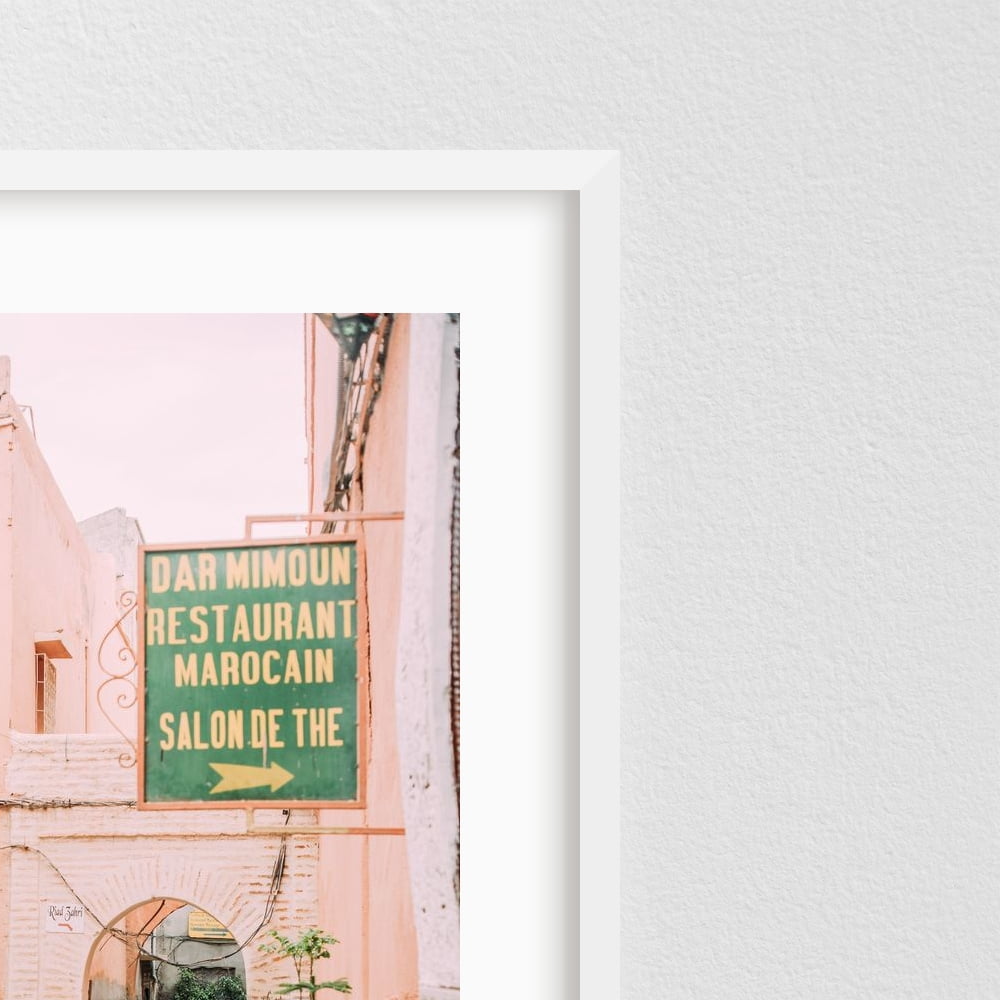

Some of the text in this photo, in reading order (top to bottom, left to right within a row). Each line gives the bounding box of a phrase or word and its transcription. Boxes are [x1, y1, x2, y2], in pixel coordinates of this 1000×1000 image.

[151, 546, 351, 594] DAR MIMOUN
[147, 600, 355, 645] RESTAURANT
[174, 648, 334, 687] MAROCAIN
[159, 707, 343, 750] SALON DE THE
[49, 905, 64, 921] Riad
